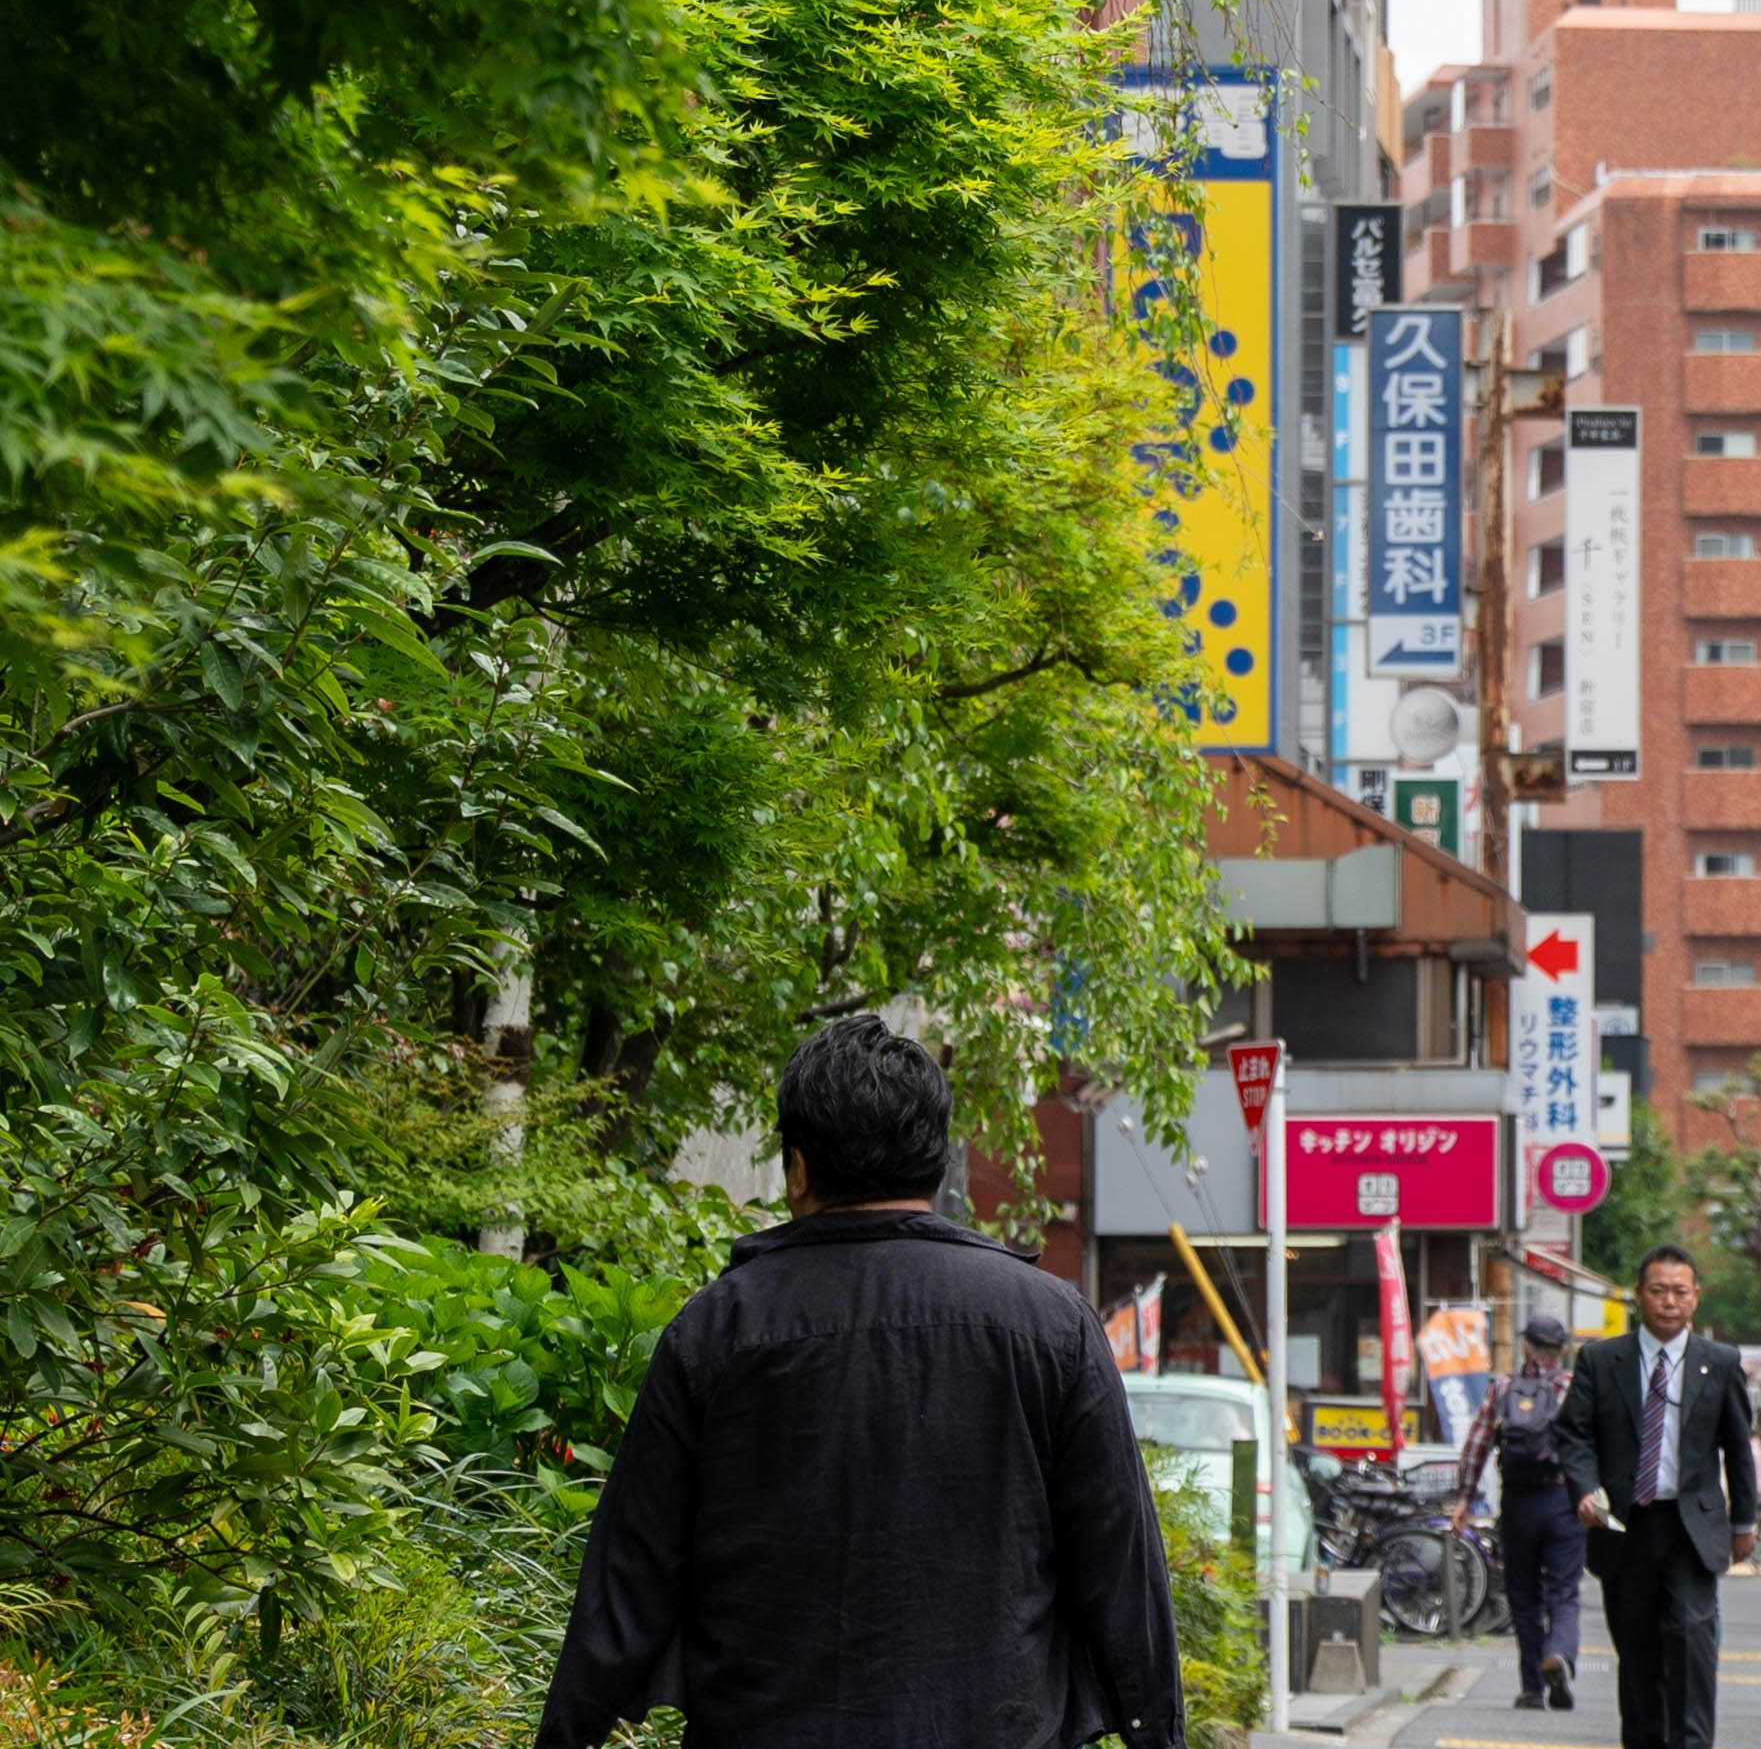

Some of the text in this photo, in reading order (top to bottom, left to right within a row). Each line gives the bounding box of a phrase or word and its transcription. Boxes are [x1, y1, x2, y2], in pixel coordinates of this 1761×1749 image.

[1382, 314, 1448, 605] 久保田歯科
[1420, 624, 1456, 646] 3F
[1237, 1054, 1271, 1082] 止まれ
[1546, 995, 1578, 1133] 整形外科
[1242, 1086, 1268, 1108] STOP
[1300, 1126, 1458, 1154] キッチン オリジン
